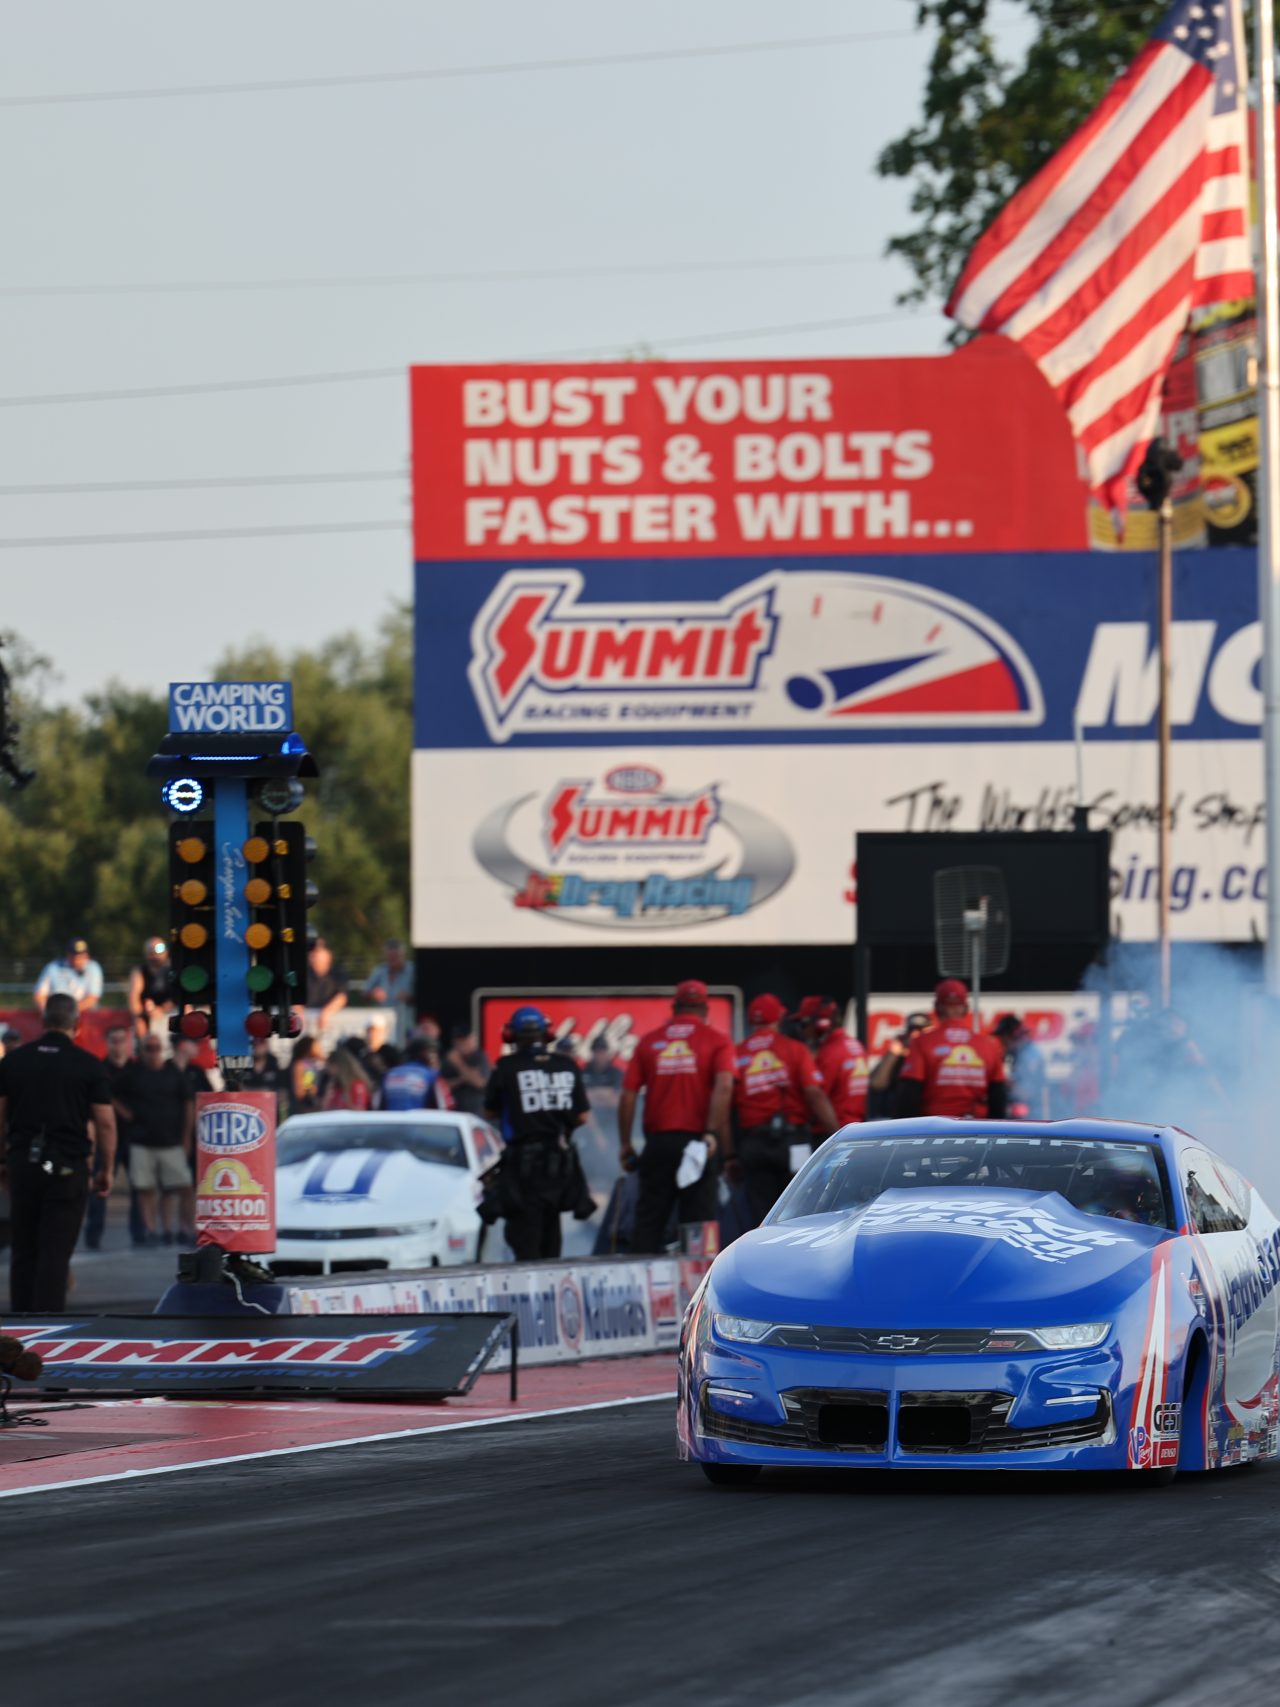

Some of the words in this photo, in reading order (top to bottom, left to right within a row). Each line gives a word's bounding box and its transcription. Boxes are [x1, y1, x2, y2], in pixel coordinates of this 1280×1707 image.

[463, 377, 635, 427] BUST
[654, 374, 833, 425] YOUR
[464, 436, 642, 486] NUTS
[661, 434, 716, 482] &
[734, 431, 933, 481] BOLTS
[465, 494, 717, 545] FASTER
[733, 490, 974, 540] WITH...
[493, 593, 764, 700] SUMMIT
[174, 684, 285, 705] CAMPING
[175, 705, 286, 731] WORLD
[551, 787, 711, 847] SUMMIT
[517, 1069, 575, 1091] Blue
[198, 1111, 261, 1145] NHRA
